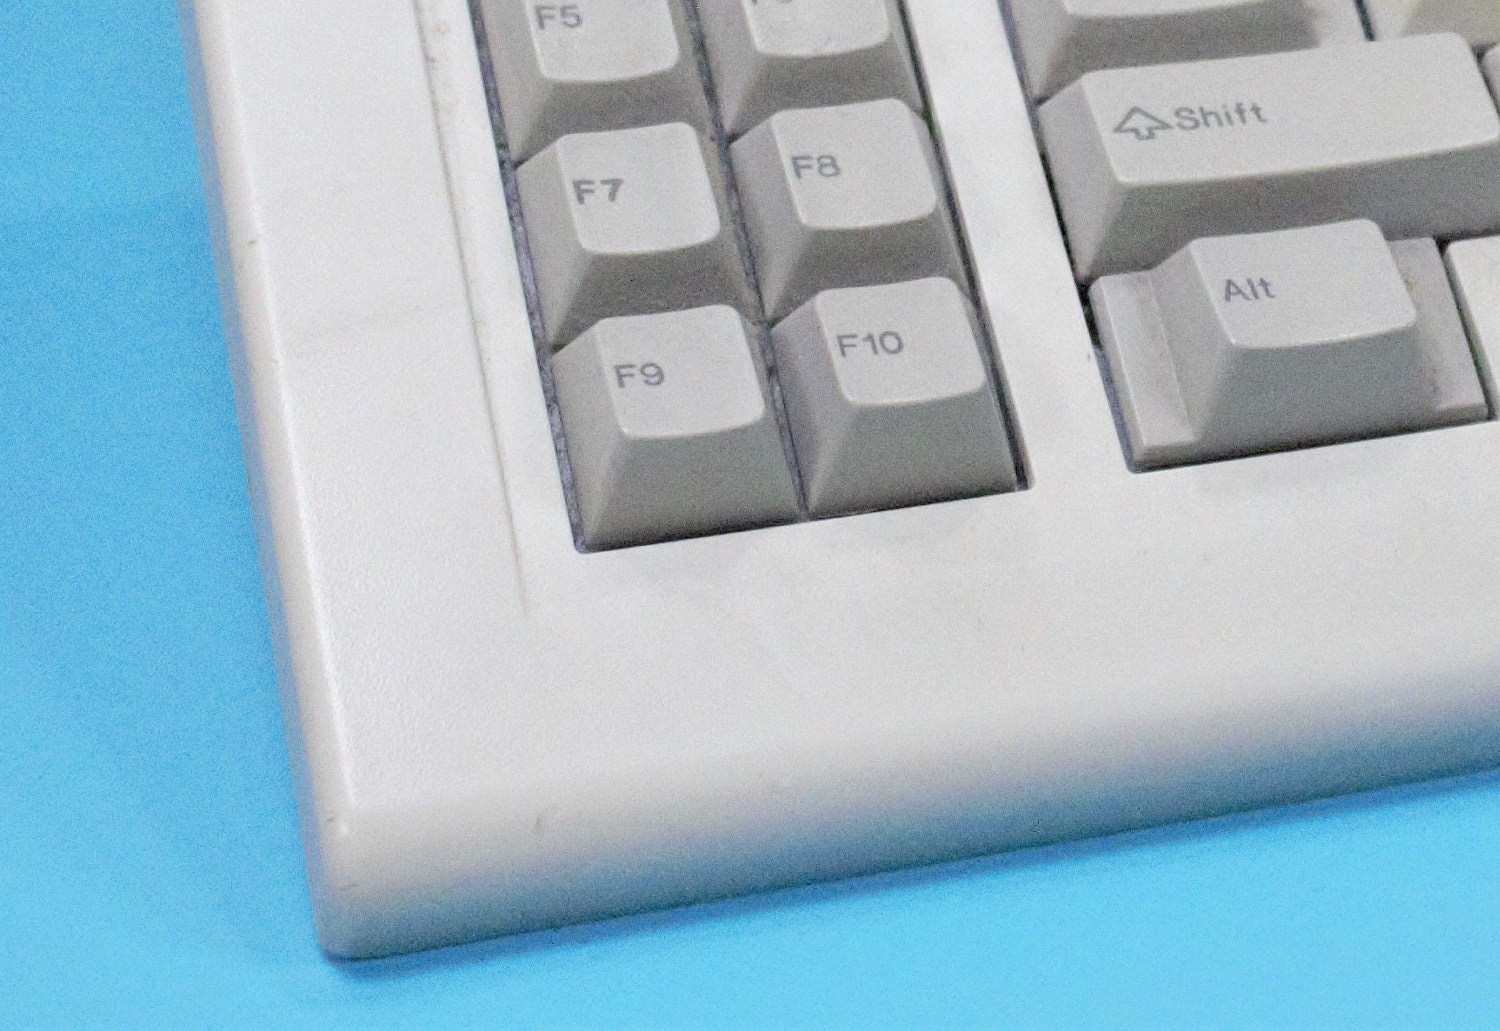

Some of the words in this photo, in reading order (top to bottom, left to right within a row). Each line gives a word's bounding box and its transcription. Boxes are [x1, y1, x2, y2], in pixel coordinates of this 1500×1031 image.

[534, 4, 582, 31] F5
[1173, 102, 1269, 131] Shift
[791, 154, 841, 180] F8
[572, 177, 625, 205] F7
[1223, 276, 1275, 303] Alt
[837, 330, 905, 359] F10
[614, 361, 665, 389] F9
